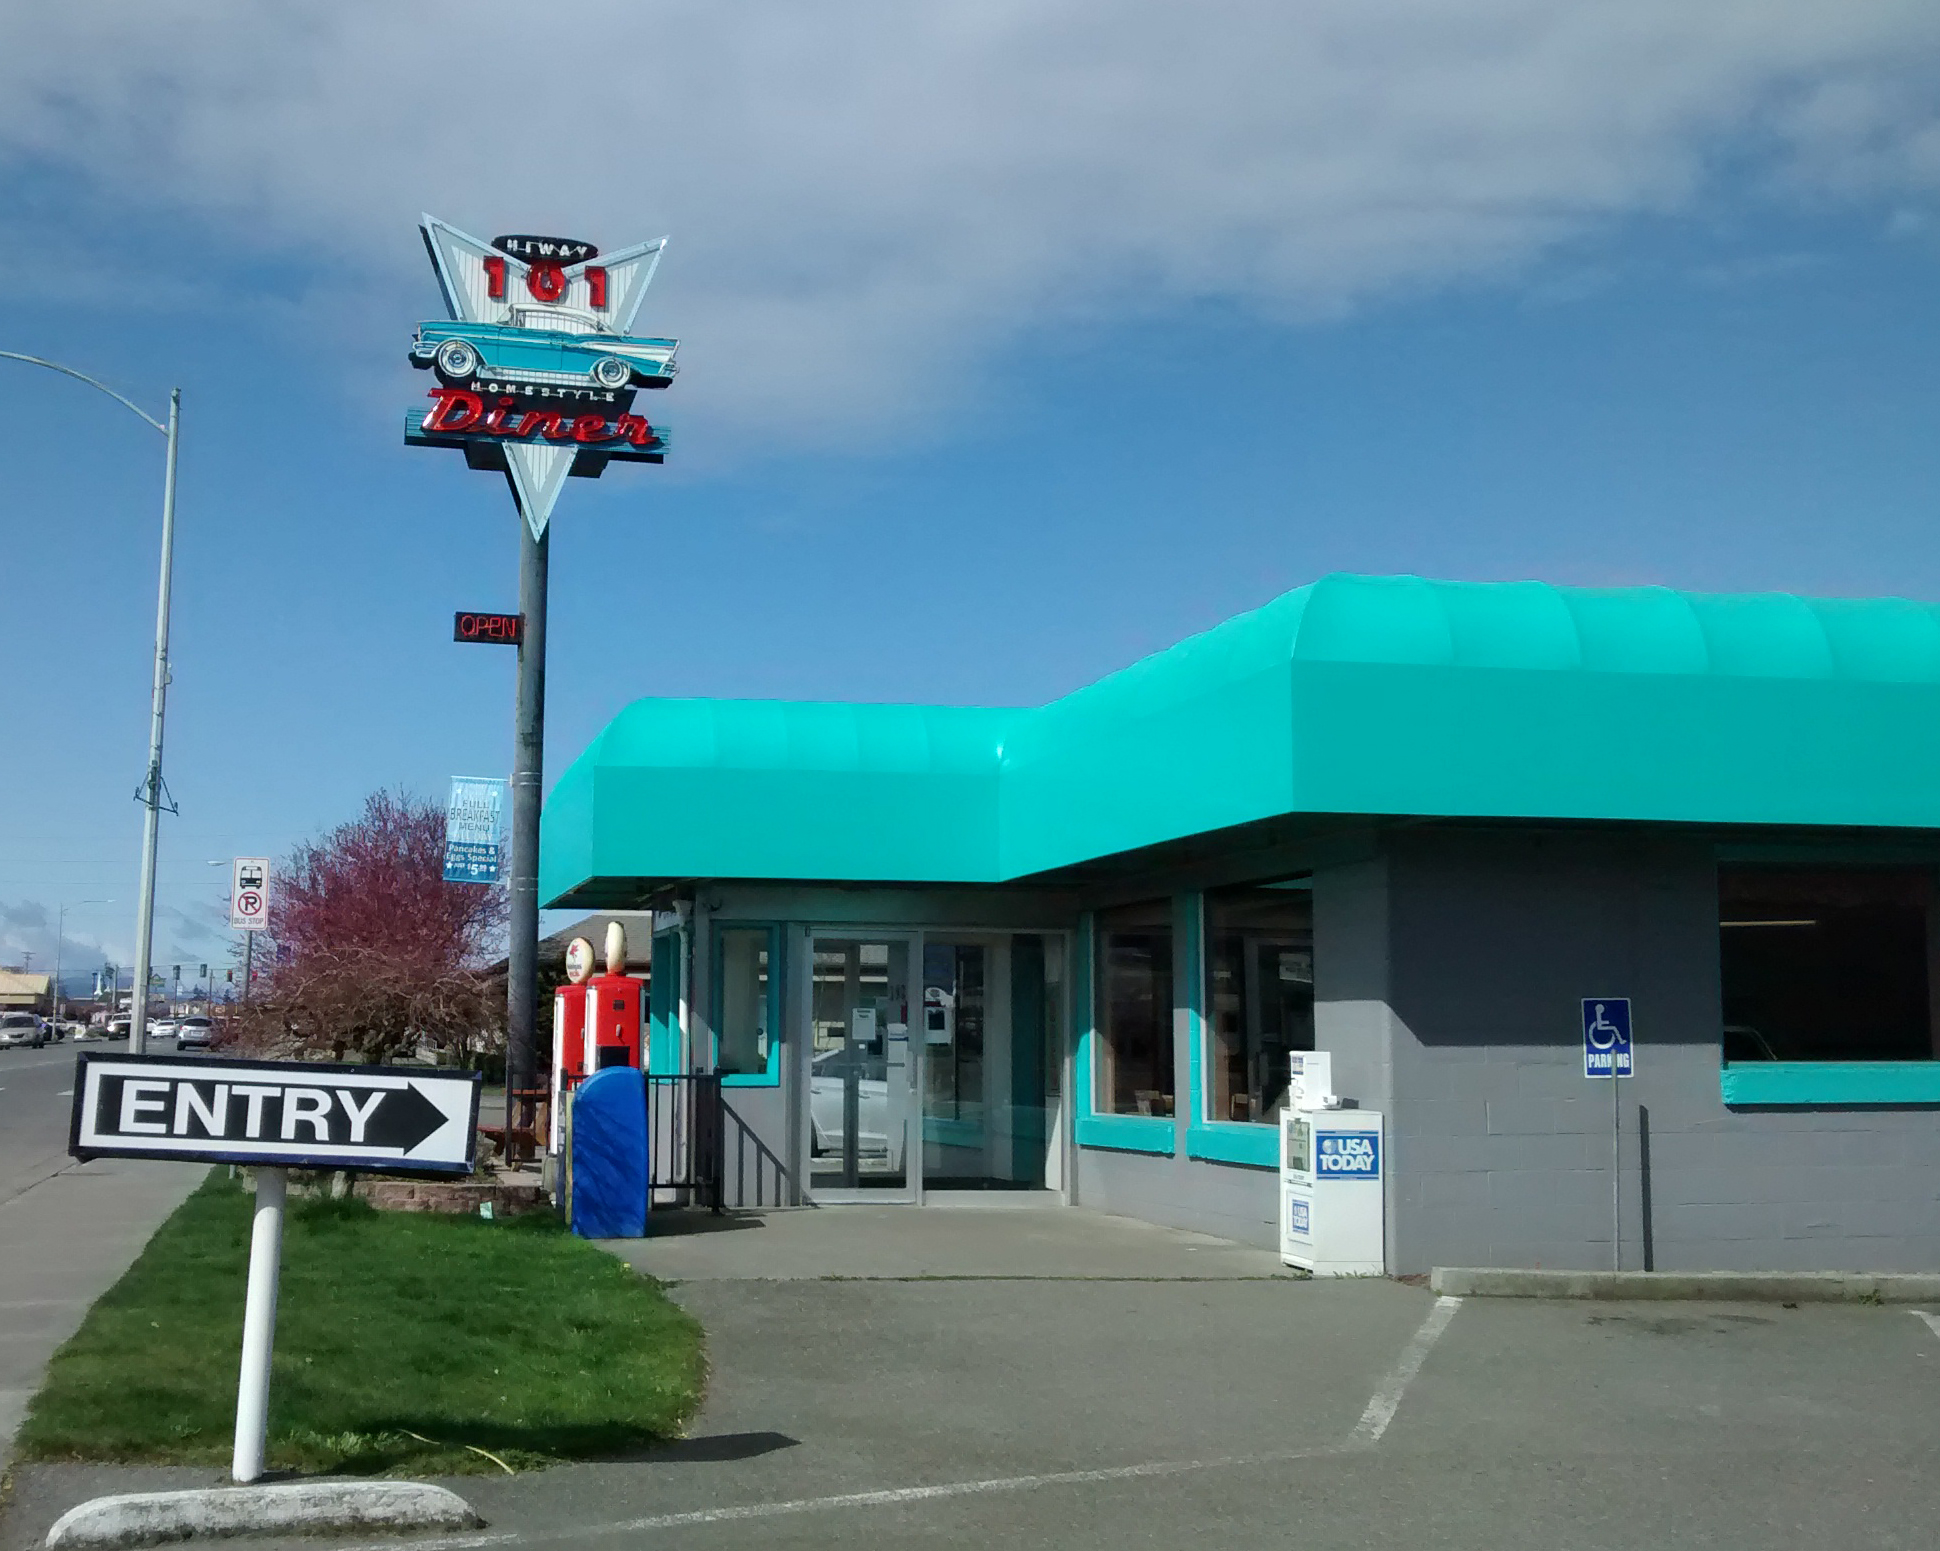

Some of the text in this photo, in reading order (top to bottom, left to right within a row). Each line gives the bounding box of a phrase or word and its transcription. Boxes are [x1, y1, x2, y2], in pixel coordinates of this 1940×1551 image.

[507, 239, 587, 256] HIWAY
[483, 256, 605, 306] 101
[471, 381, 614, 402] HOMESTYLE
[422, 388, 659, 445] Diner
[461, 615, 516, 637] OPEN
[463, 800, 489, 809] FULL
[450, 808, 500, 823] BREAKFAST
[458, 822, 490, 831] MENU
[446, 852, 497, 863] Eggs Special
[449, 844, 496, 855] Pancakes &
[233, 917, 264, 925] BUS STOP
[1588, 1053, 1630, 1068] PARKNG
[119, 1080, 386, 1142] ENTRY
[1337, 1138, 1373, 1155] USA
[1320, 1154, 1375, 1171] TODAY
